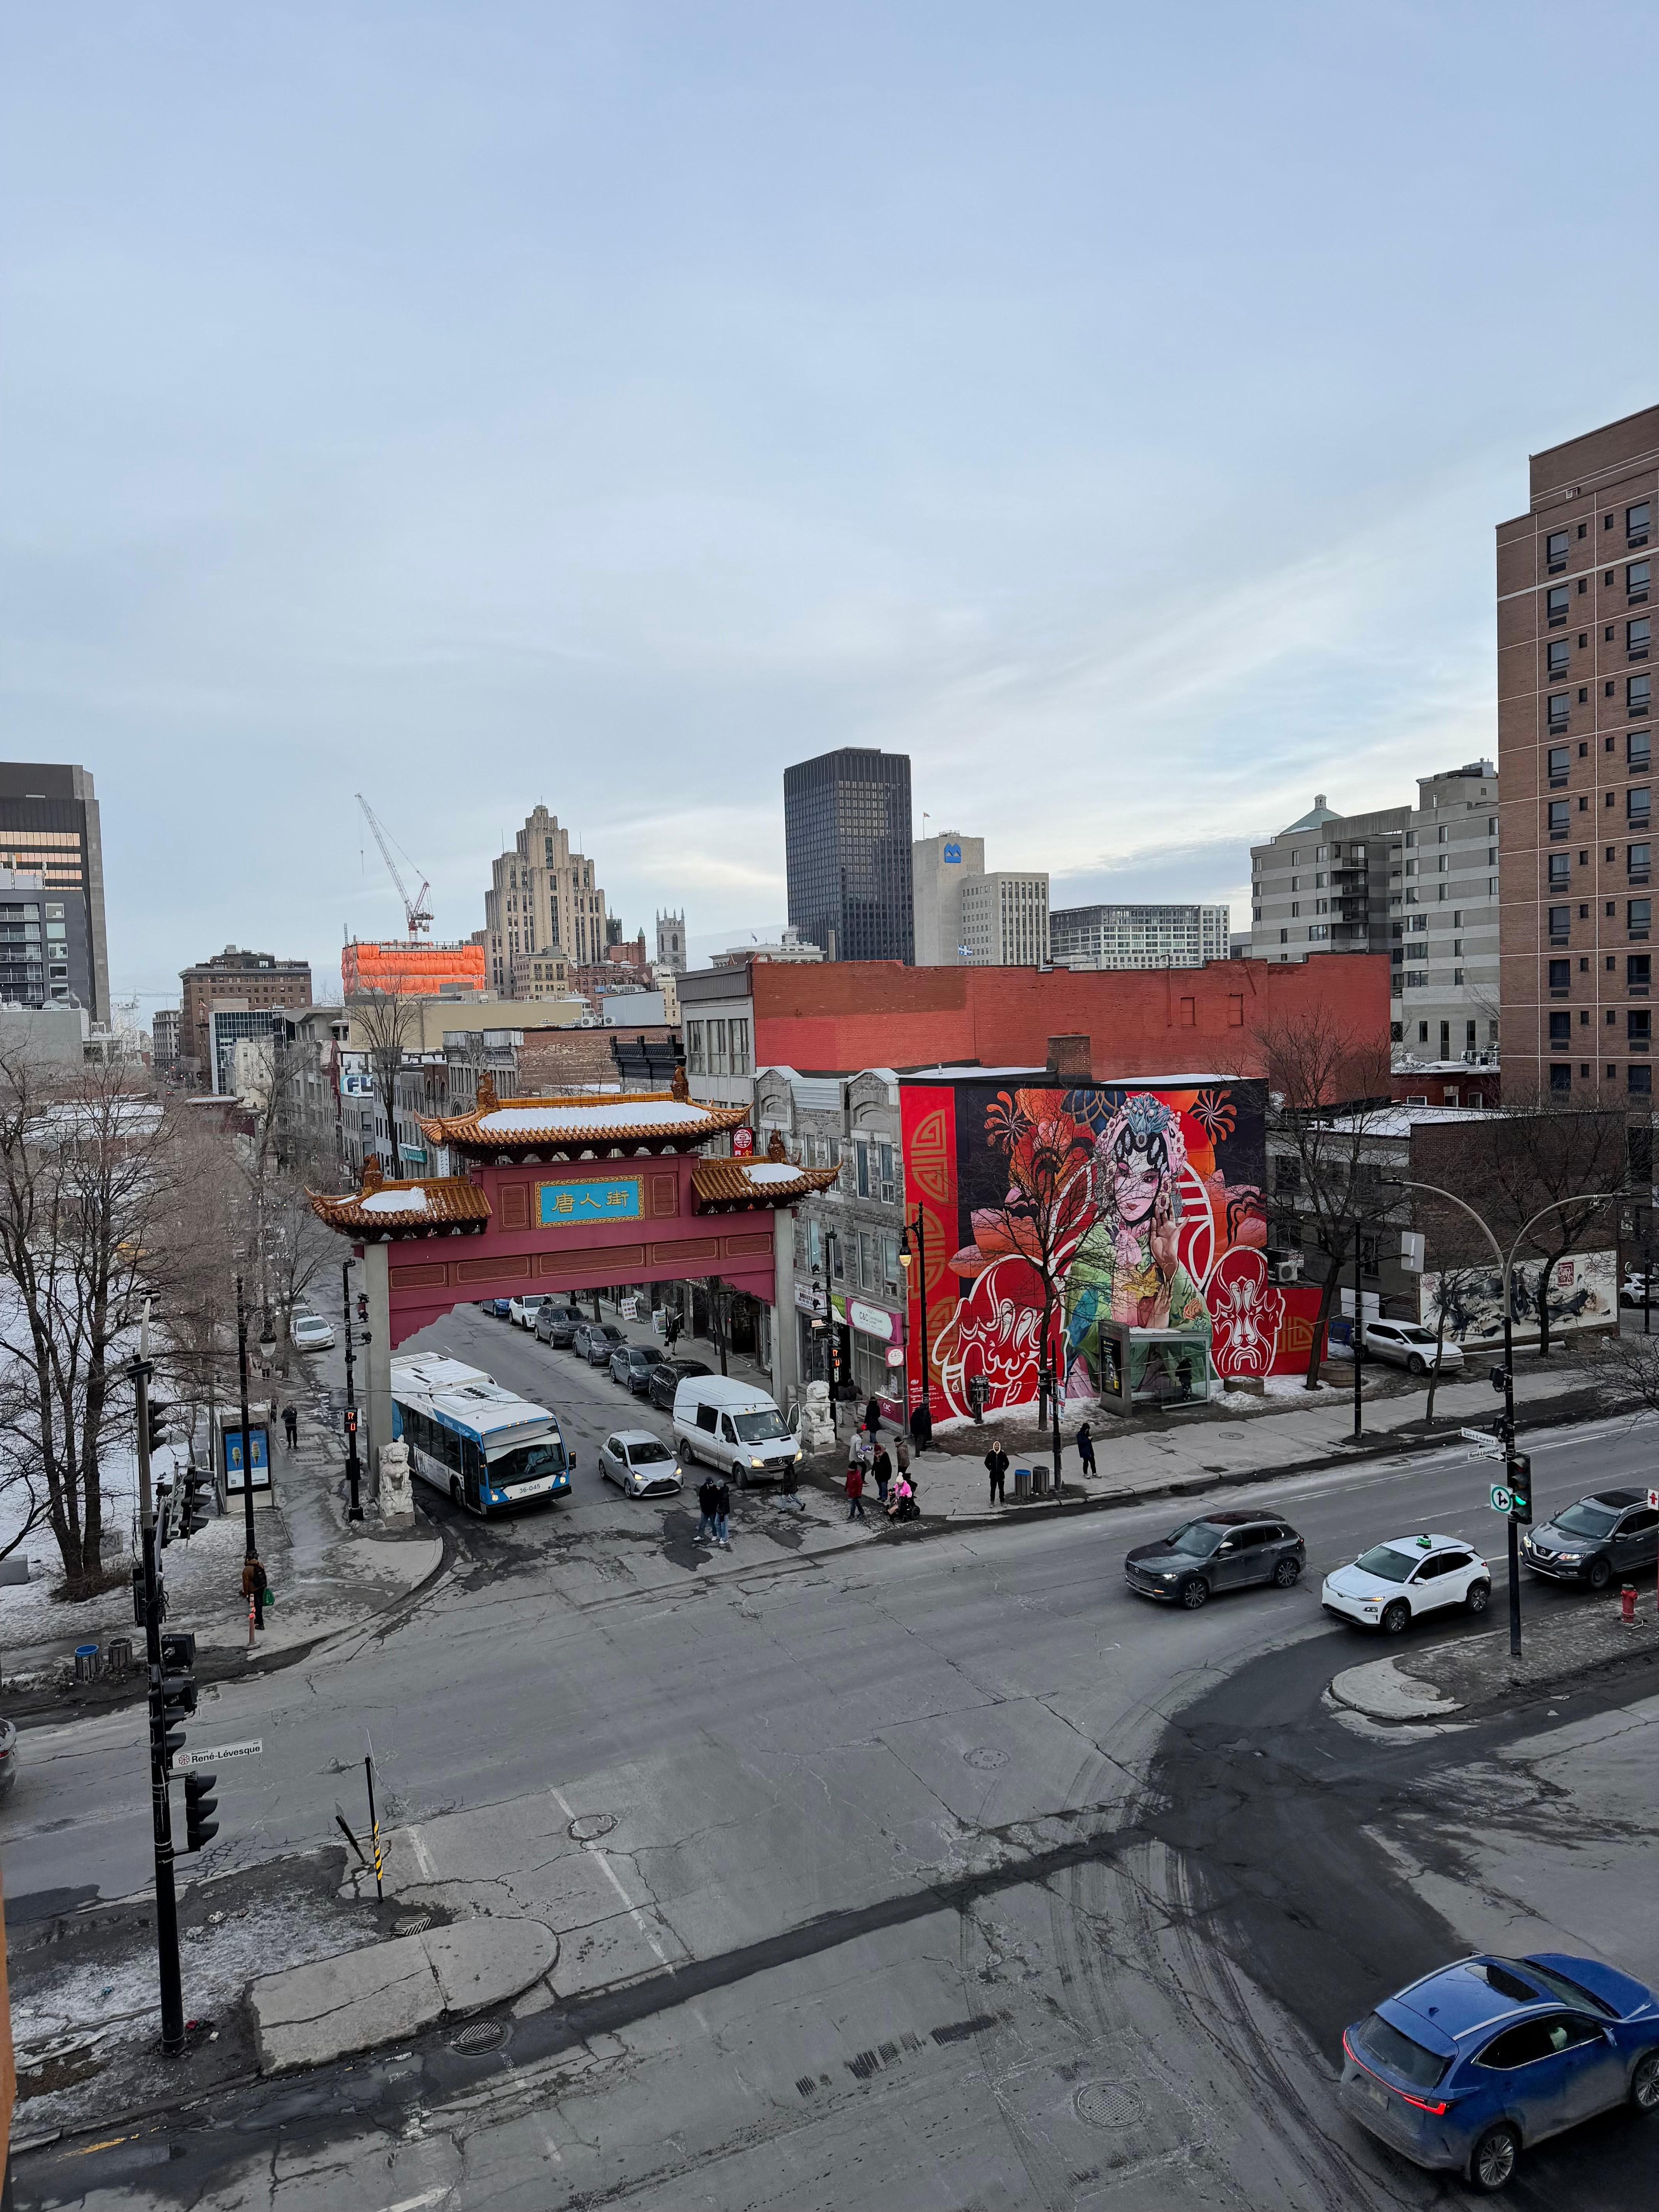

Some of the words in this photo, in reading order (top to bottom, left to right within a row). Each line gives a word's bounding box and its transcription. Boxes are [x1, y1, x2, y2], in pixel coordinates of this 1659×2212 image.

[551, 1190, 629, 1214] 唐人街
[860, 1312, 868, 1321] C&C
[1463, 1431, 1494, 1444] Saint-Laurent
[1469, 1448, 1499, 1458] René-Lévesque
[519, 1484, 540, 1494] 36-045
[192, 1746, 260, 1763] René-Lévesque
